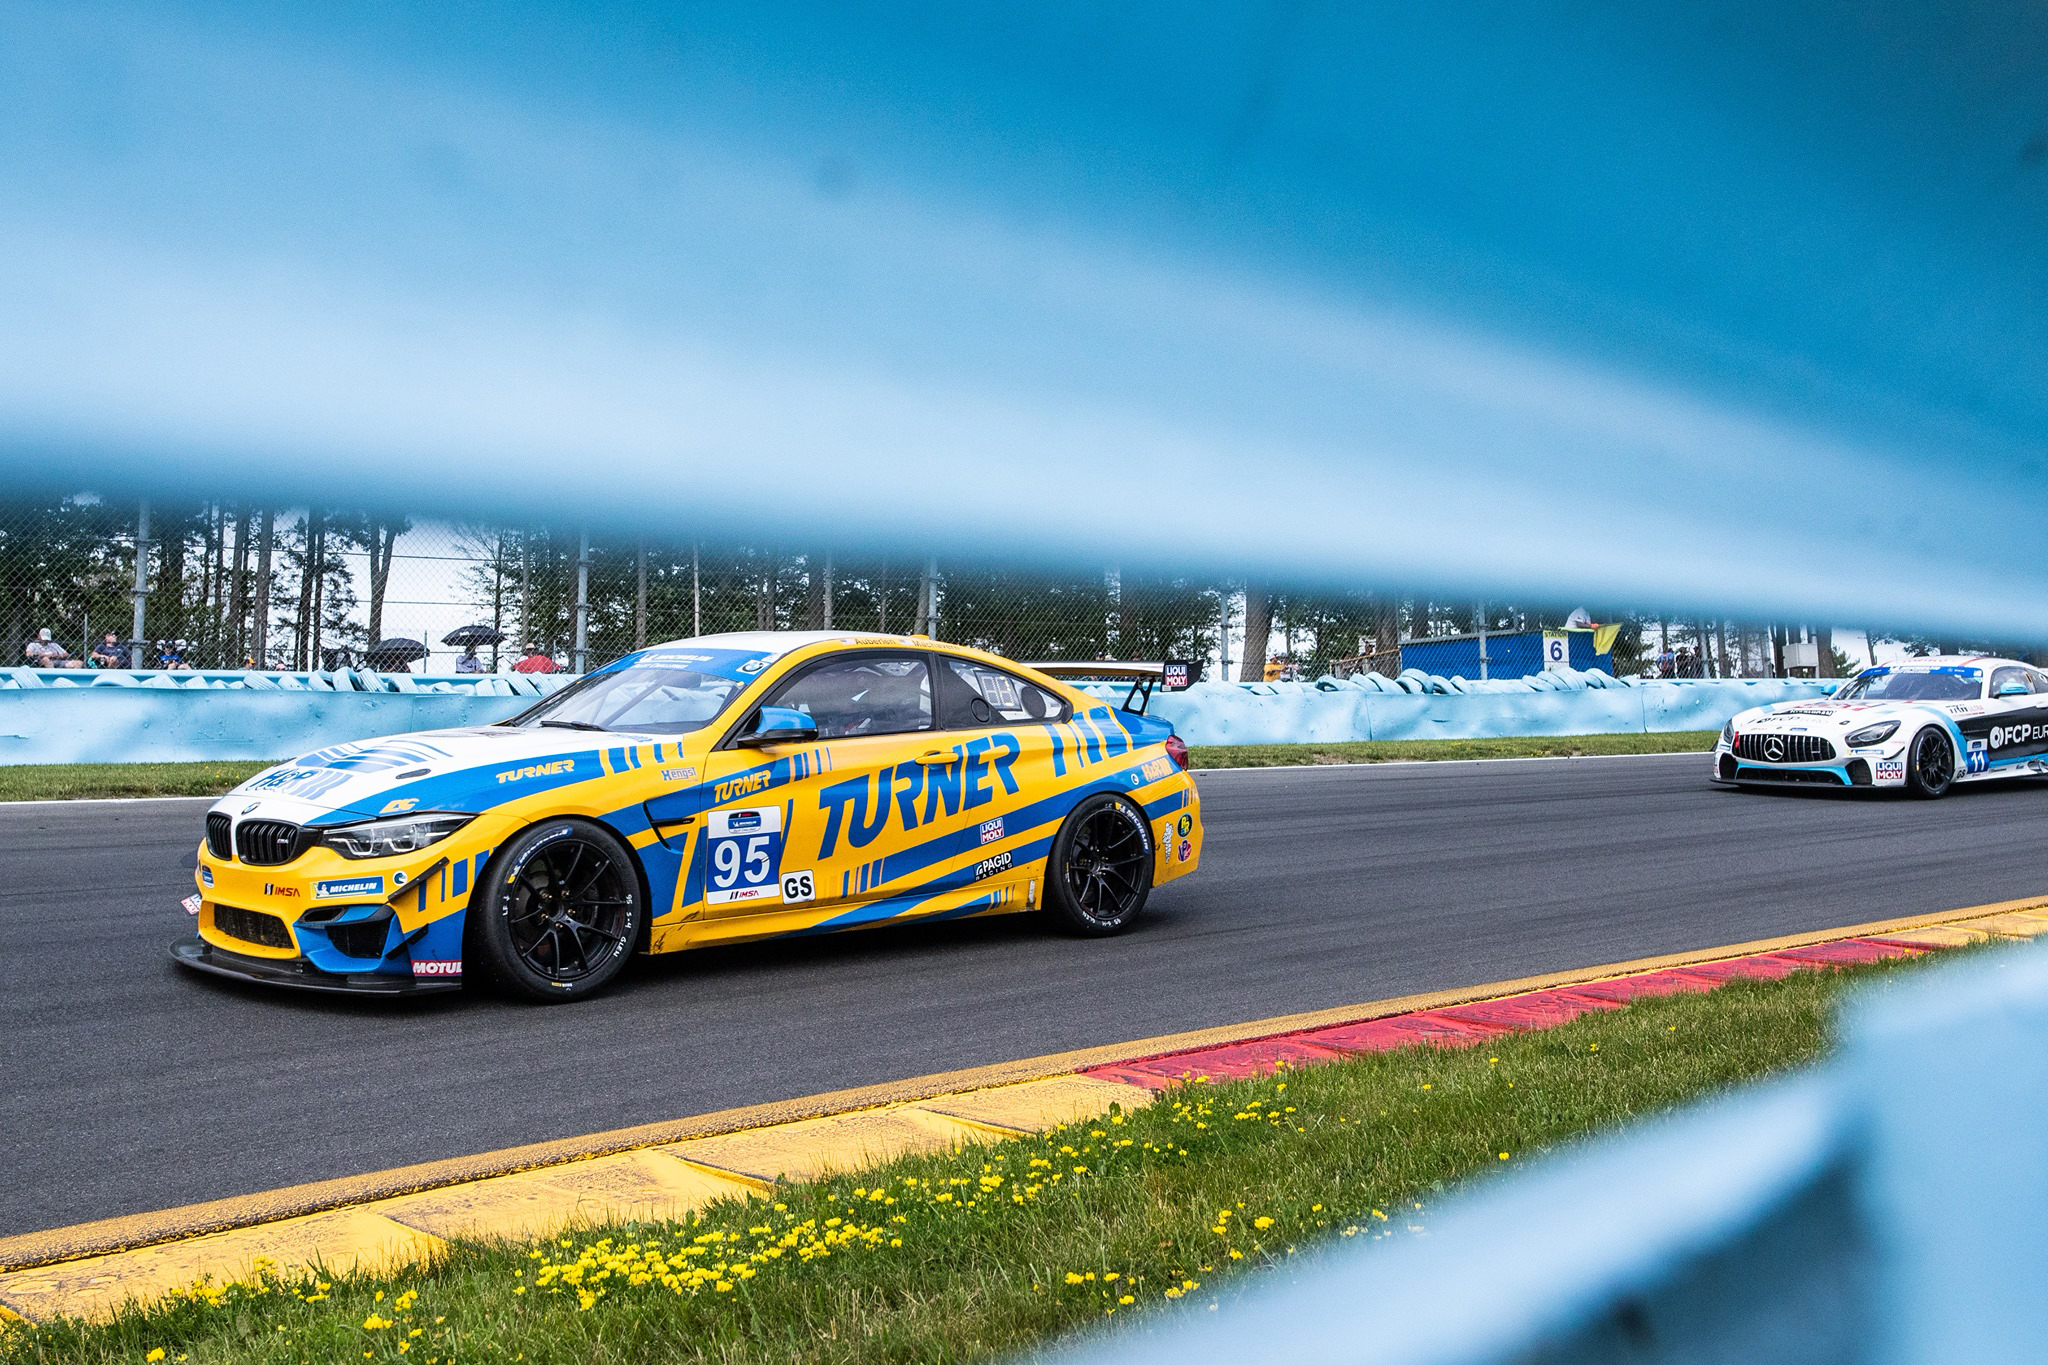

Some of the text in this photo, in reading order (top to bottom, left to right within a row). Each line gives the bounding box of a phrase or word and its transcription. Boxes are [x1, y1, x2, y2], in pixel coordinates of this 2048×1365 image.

[854, 638, 896, 646] Auberlen
[912, 640, 960, 651] Machavern
[1549, 640, 1563, 661] 6
[1166, 666, 1186, 675] LIQUI
[1166, 676, 1186, 685] MOLY
[2004, 724, 2032, 745] FCP
[1971, 751, 1985, 772] 11
[495, 759, 575, 783] TURNER
[1877, 771, 1903, 779] MOLY
[1957, 769, 1966, 778] GS
[714, 770, 771, 803] TURNER
[818, 731, 1021, 860] TURNER
[981, 819, 1002, 833] LIQUI
[1126, 809, 1149, 851] MICHELIN
[982, 828, 1003, 842] MOLY
[713, 835, 771, 888] 95
[982, 852, 1012, 873] PAGID
[975, 862, 1013, 881] RACING
[275, 886, 301, 897] IMSA
[330, 882, 378, 893] MICHELIN
[738, 890, 760, 898] IMSA
[784, 875, 813, 899] GS
[613, 936, 627, 957] GLEN
[413, 962, 463, 974] MOTUL
